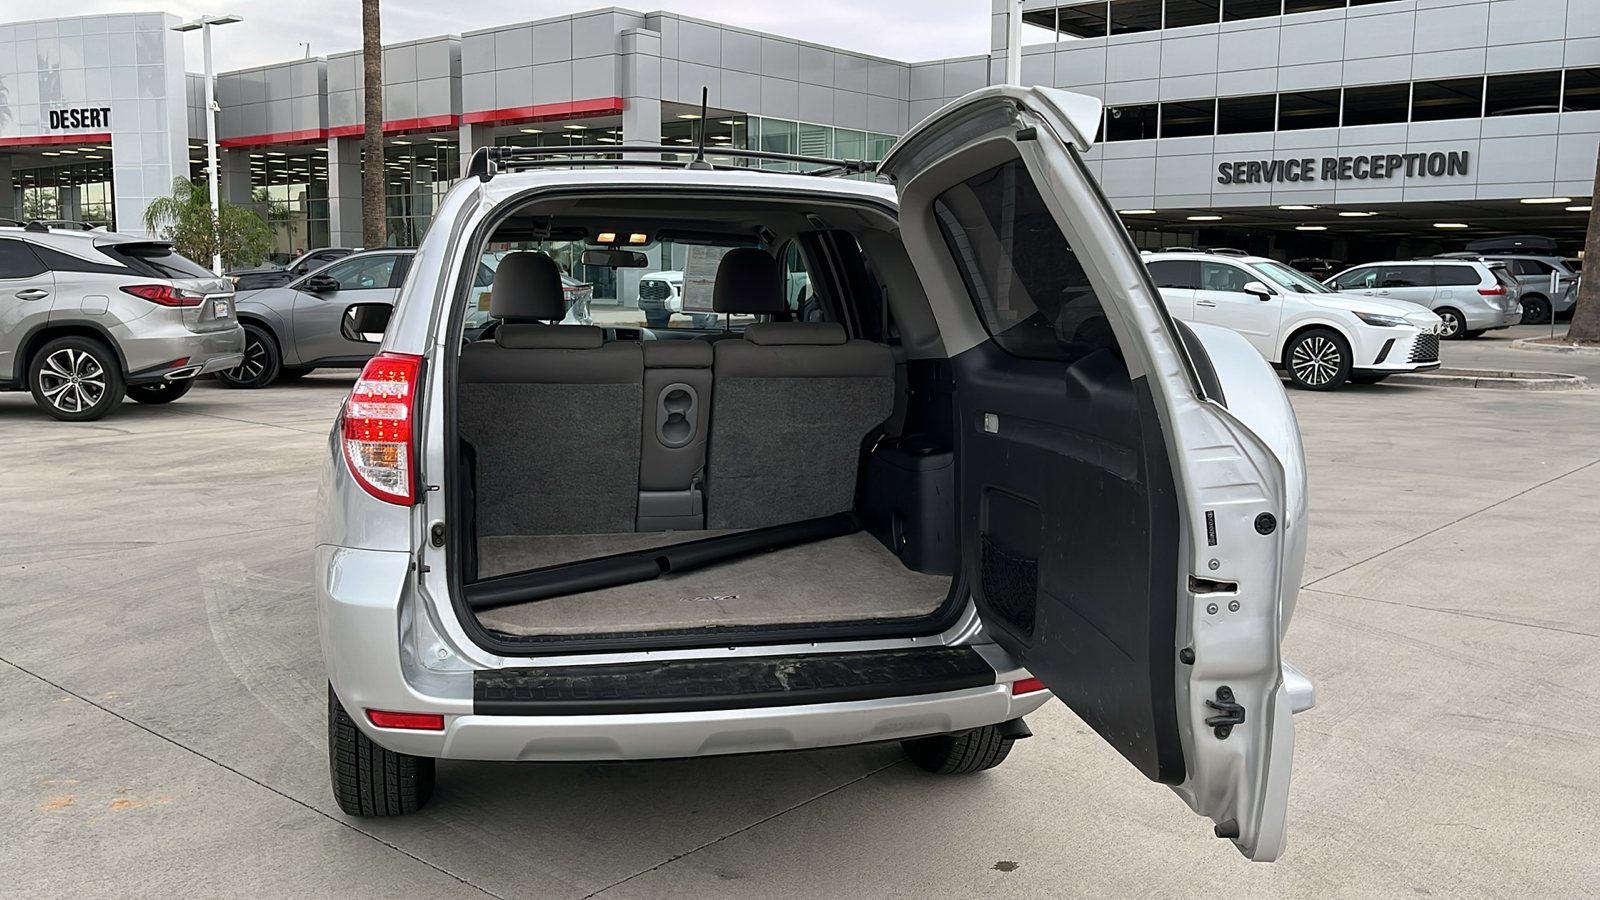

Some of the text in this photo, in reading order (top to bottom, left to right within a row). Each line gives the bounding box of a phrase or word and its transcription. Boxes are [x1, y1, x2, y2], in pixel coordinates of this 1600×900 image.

[49, 107, 111, 130] DESERT
[1217, 151, 1469, 184] SERVICE RECEPTION
